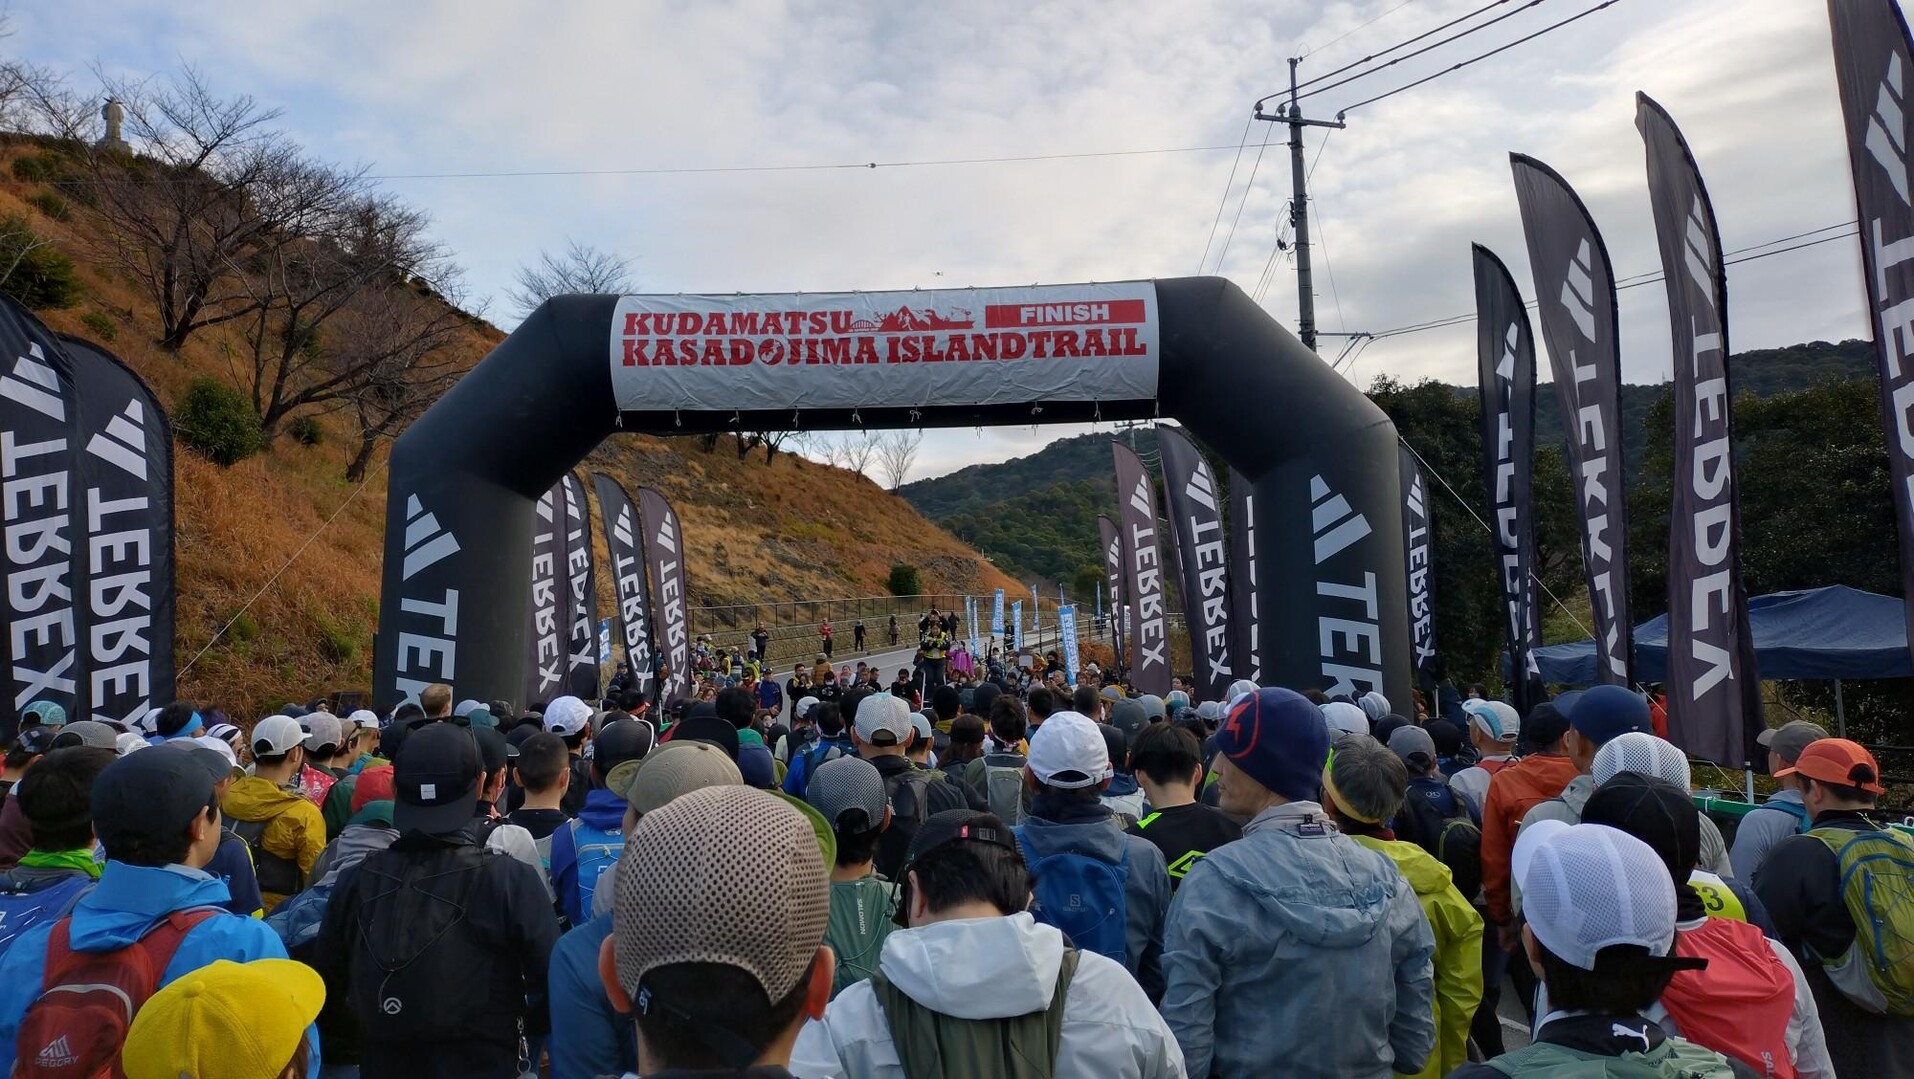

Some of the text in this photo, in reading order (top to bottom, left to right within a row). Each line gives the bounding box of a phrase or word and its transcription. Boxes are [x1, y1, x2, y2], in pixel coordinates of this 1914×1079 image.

[623, 311, 853, 336] KUDAMATSU
[1020, 303, 1110, 324] FINISH
[857, 897, 866, 935] SALOMON
